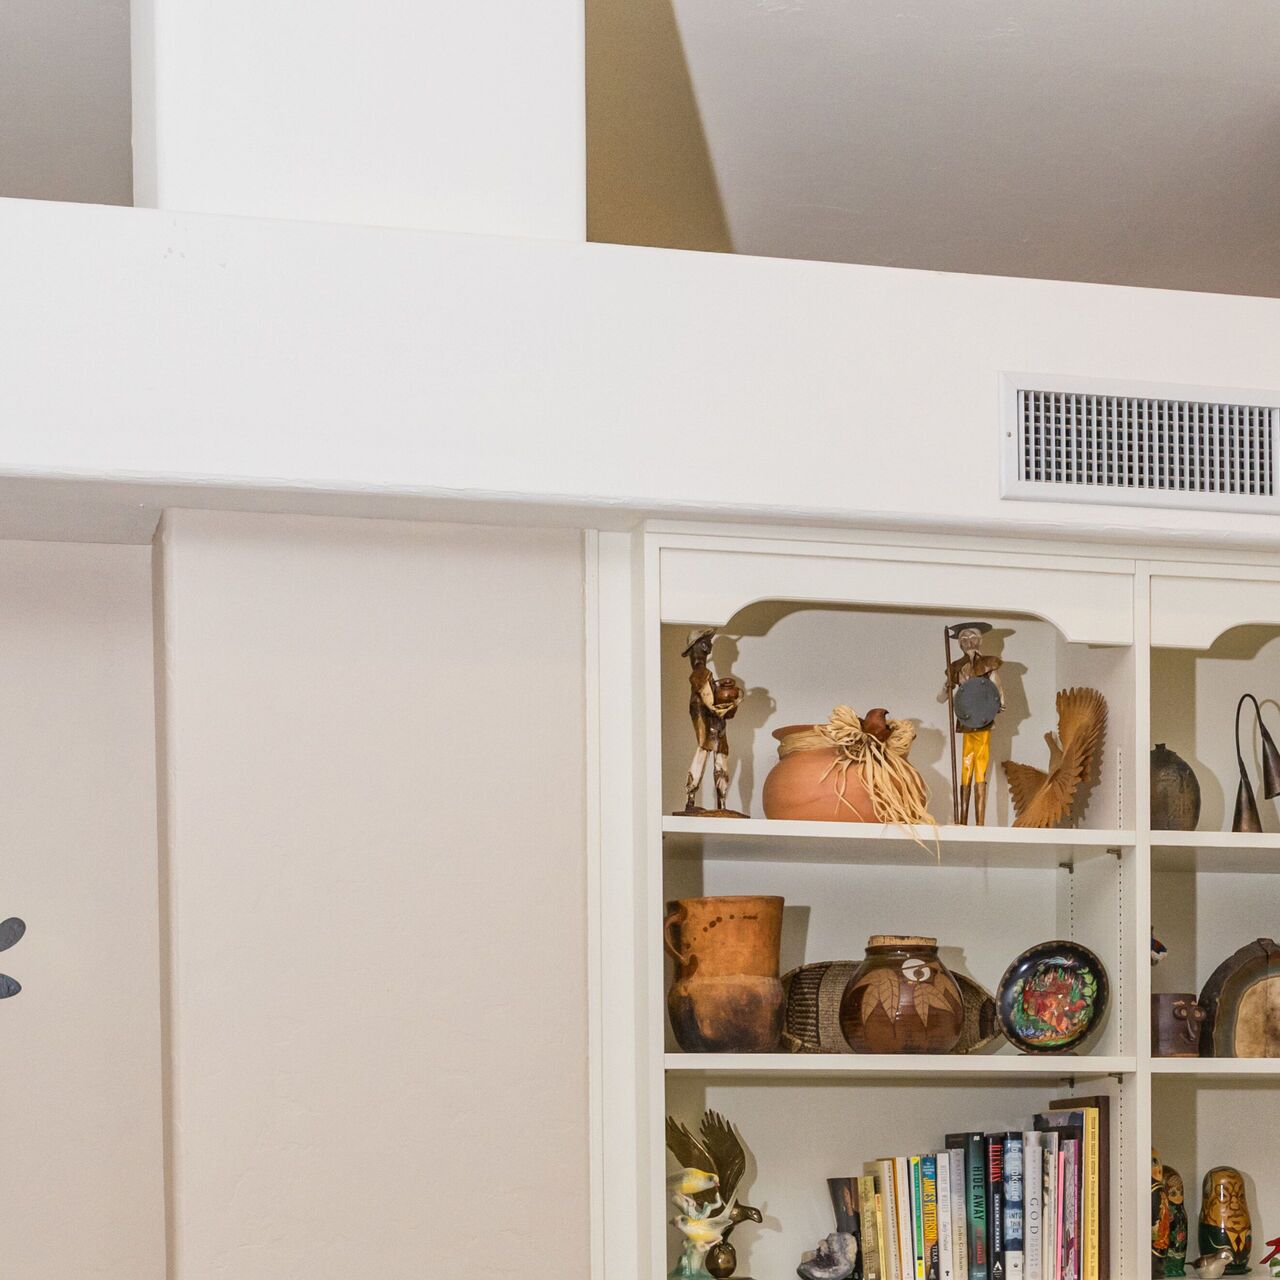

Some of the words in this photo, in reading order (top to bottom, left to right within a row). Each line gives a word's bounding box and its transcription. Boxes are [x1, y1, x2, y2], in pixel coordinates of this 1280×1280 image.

[923, 1178, 937, 1201] JAMES
[972, 1166, 984, 1190] HIDE
[924, 1202, 937, 1240] PATTERSON
[973, 1194, 985, 1221] AWAY
[1030, 1197, 1039, 1235] GOD
